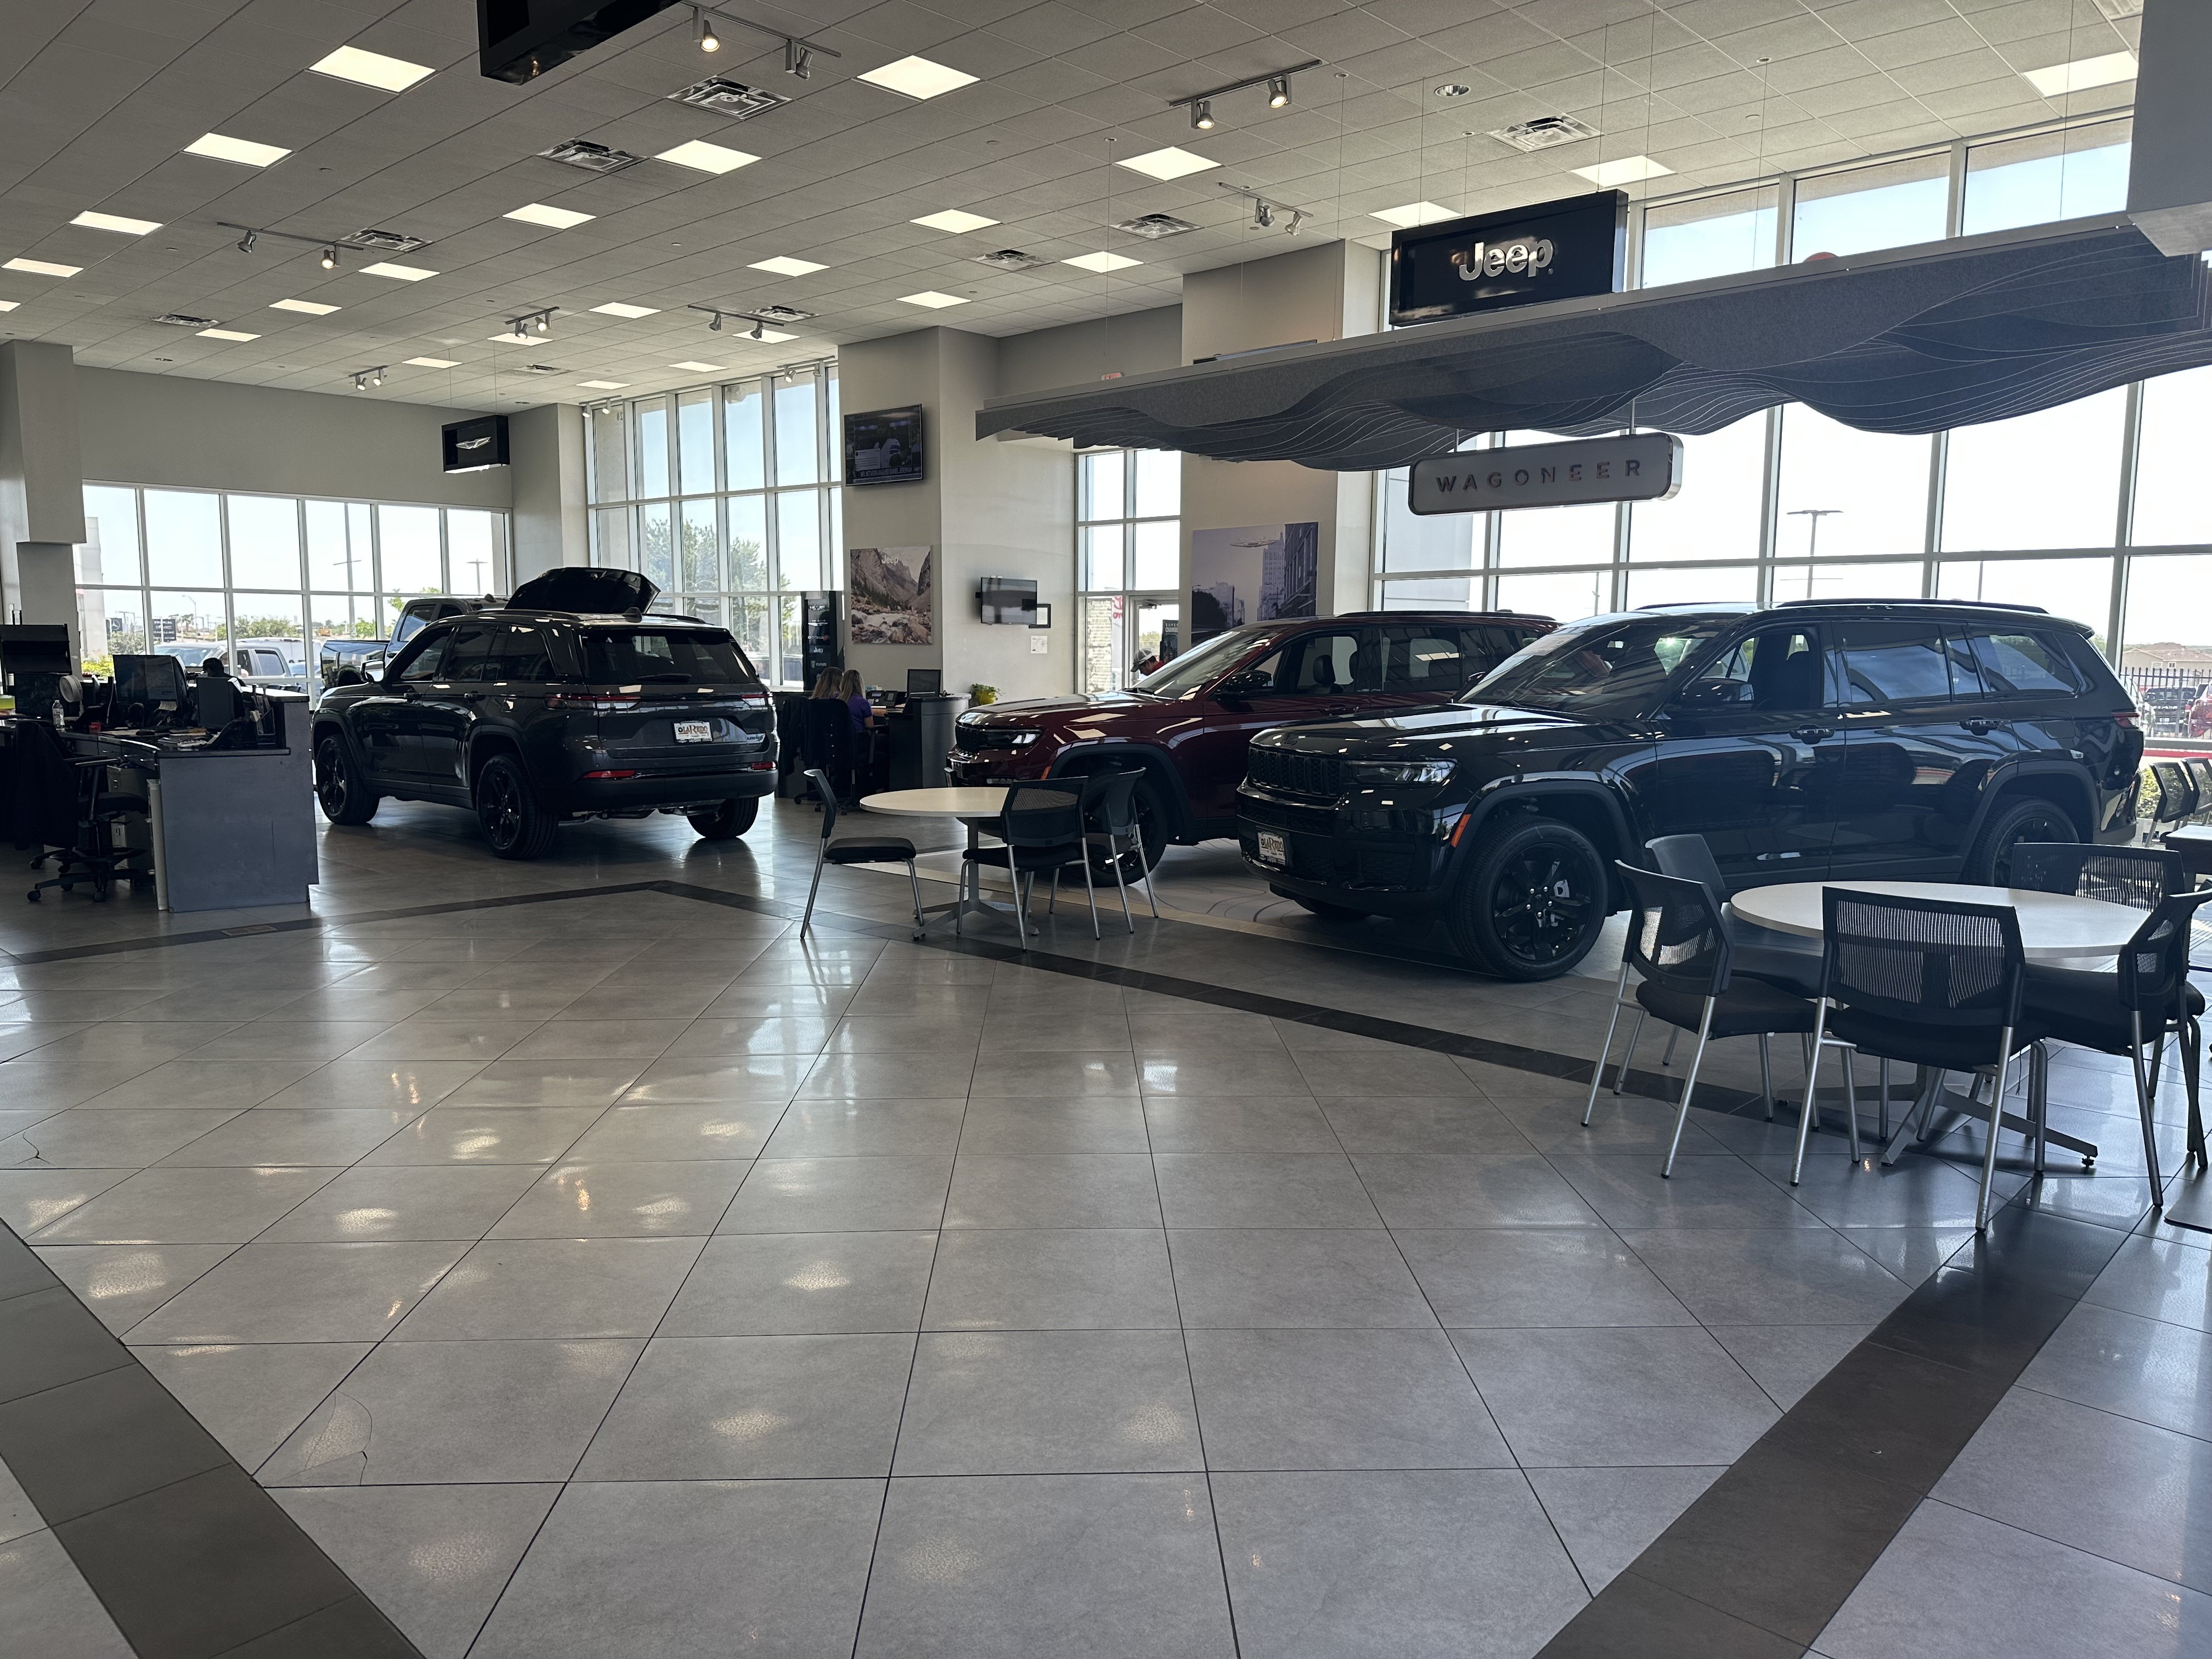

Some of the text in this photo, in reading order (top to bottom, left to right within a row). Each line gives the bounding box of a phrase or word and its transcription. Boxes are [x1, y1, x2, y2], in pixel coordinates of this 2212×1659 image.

[1459, 239, 1554, 281] Jeep
[1436, 459, 1640, 492] WAGONEER
[881, 554, 899, 565] Jeep
[682, 725, 708, 734] LAREDO
